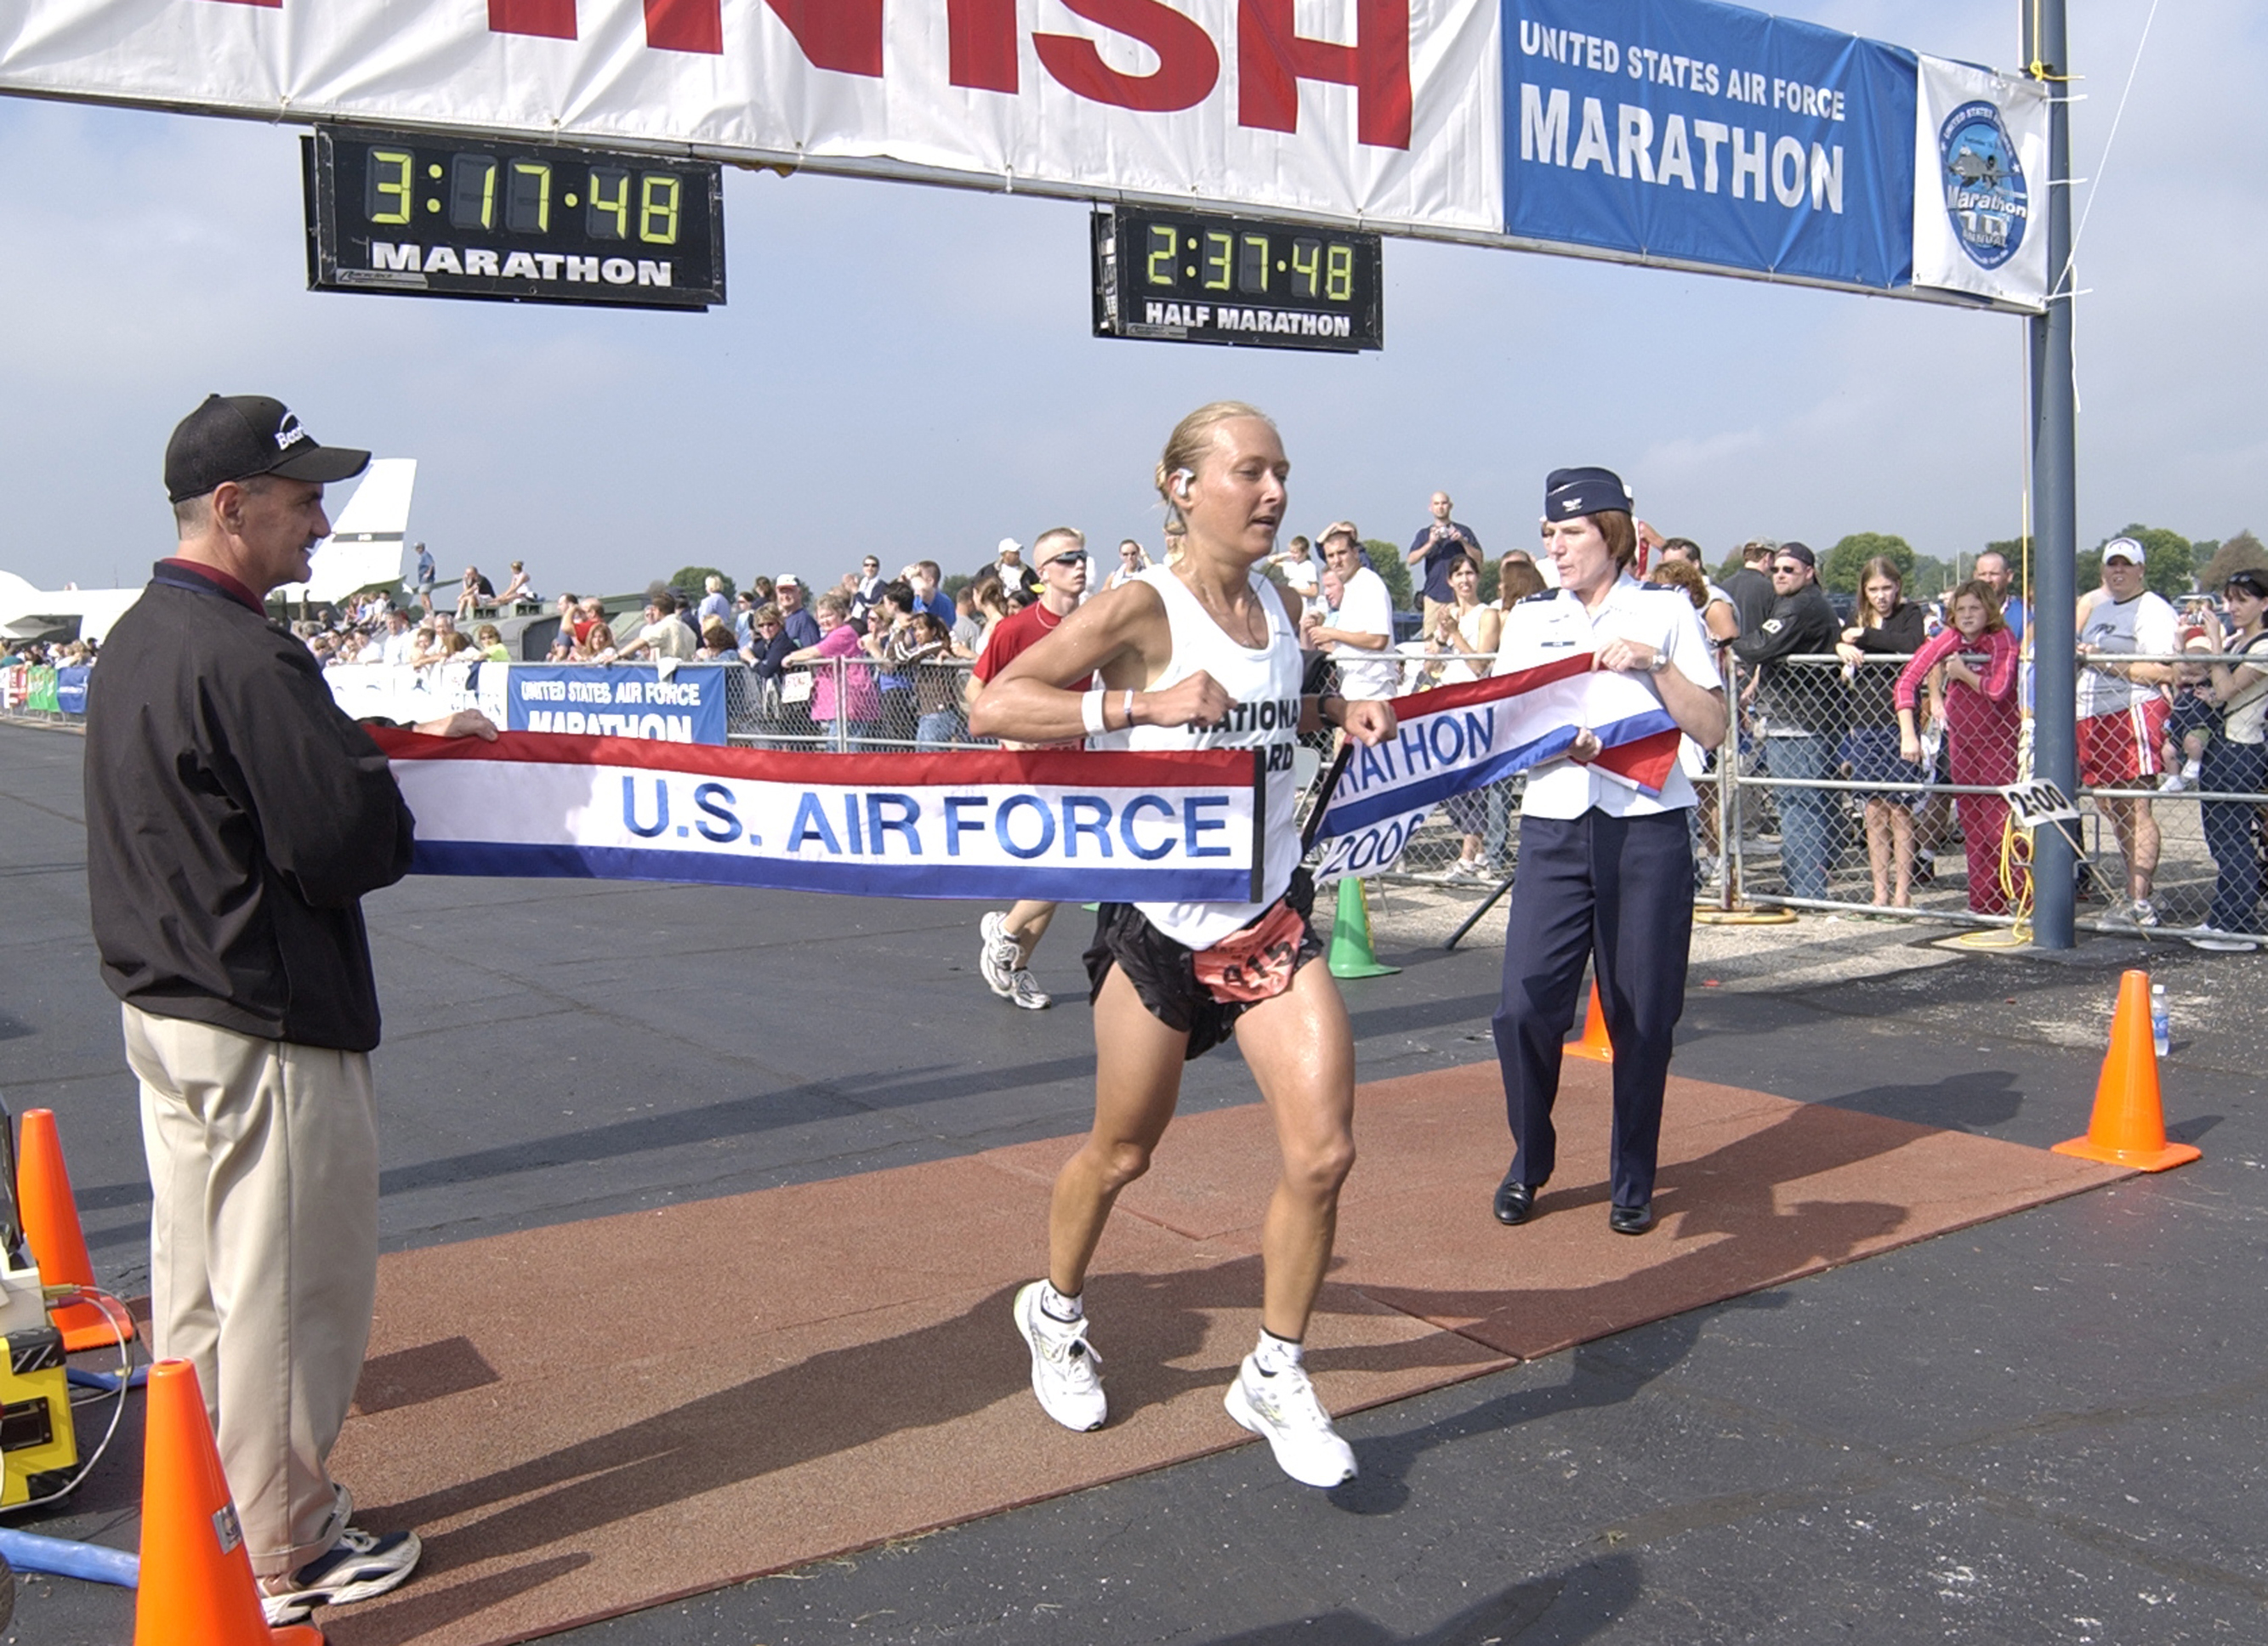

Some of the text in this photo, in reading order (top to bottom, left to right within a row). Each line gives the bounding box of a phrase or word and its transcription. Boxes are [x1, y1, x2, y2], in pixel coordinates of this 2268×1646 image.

[202, 0, 1412, 150] ISH
[1520, 20, 1845, 122] UNITED STATES AIR FORCE
[1520, 82, 1844, 214] MARATHON
[1947, 184, 2027, 218] Marathon
[372, 242, 673, 287] MARATHON
[1145, 303, 1350, 338] HALF MARATHON
[521, 681, 566, 701] UNITED
[568, 682, 611, 704] STATES
[615, 682, 642, 704] AIR
[645, 682, 701, 706] FORCE
[1332, 707, 1494, 801] RATHON
[622, 775, 1231, 860] U.S. AIR FORCE
[2008, 784, 2068, 817] 2:00
